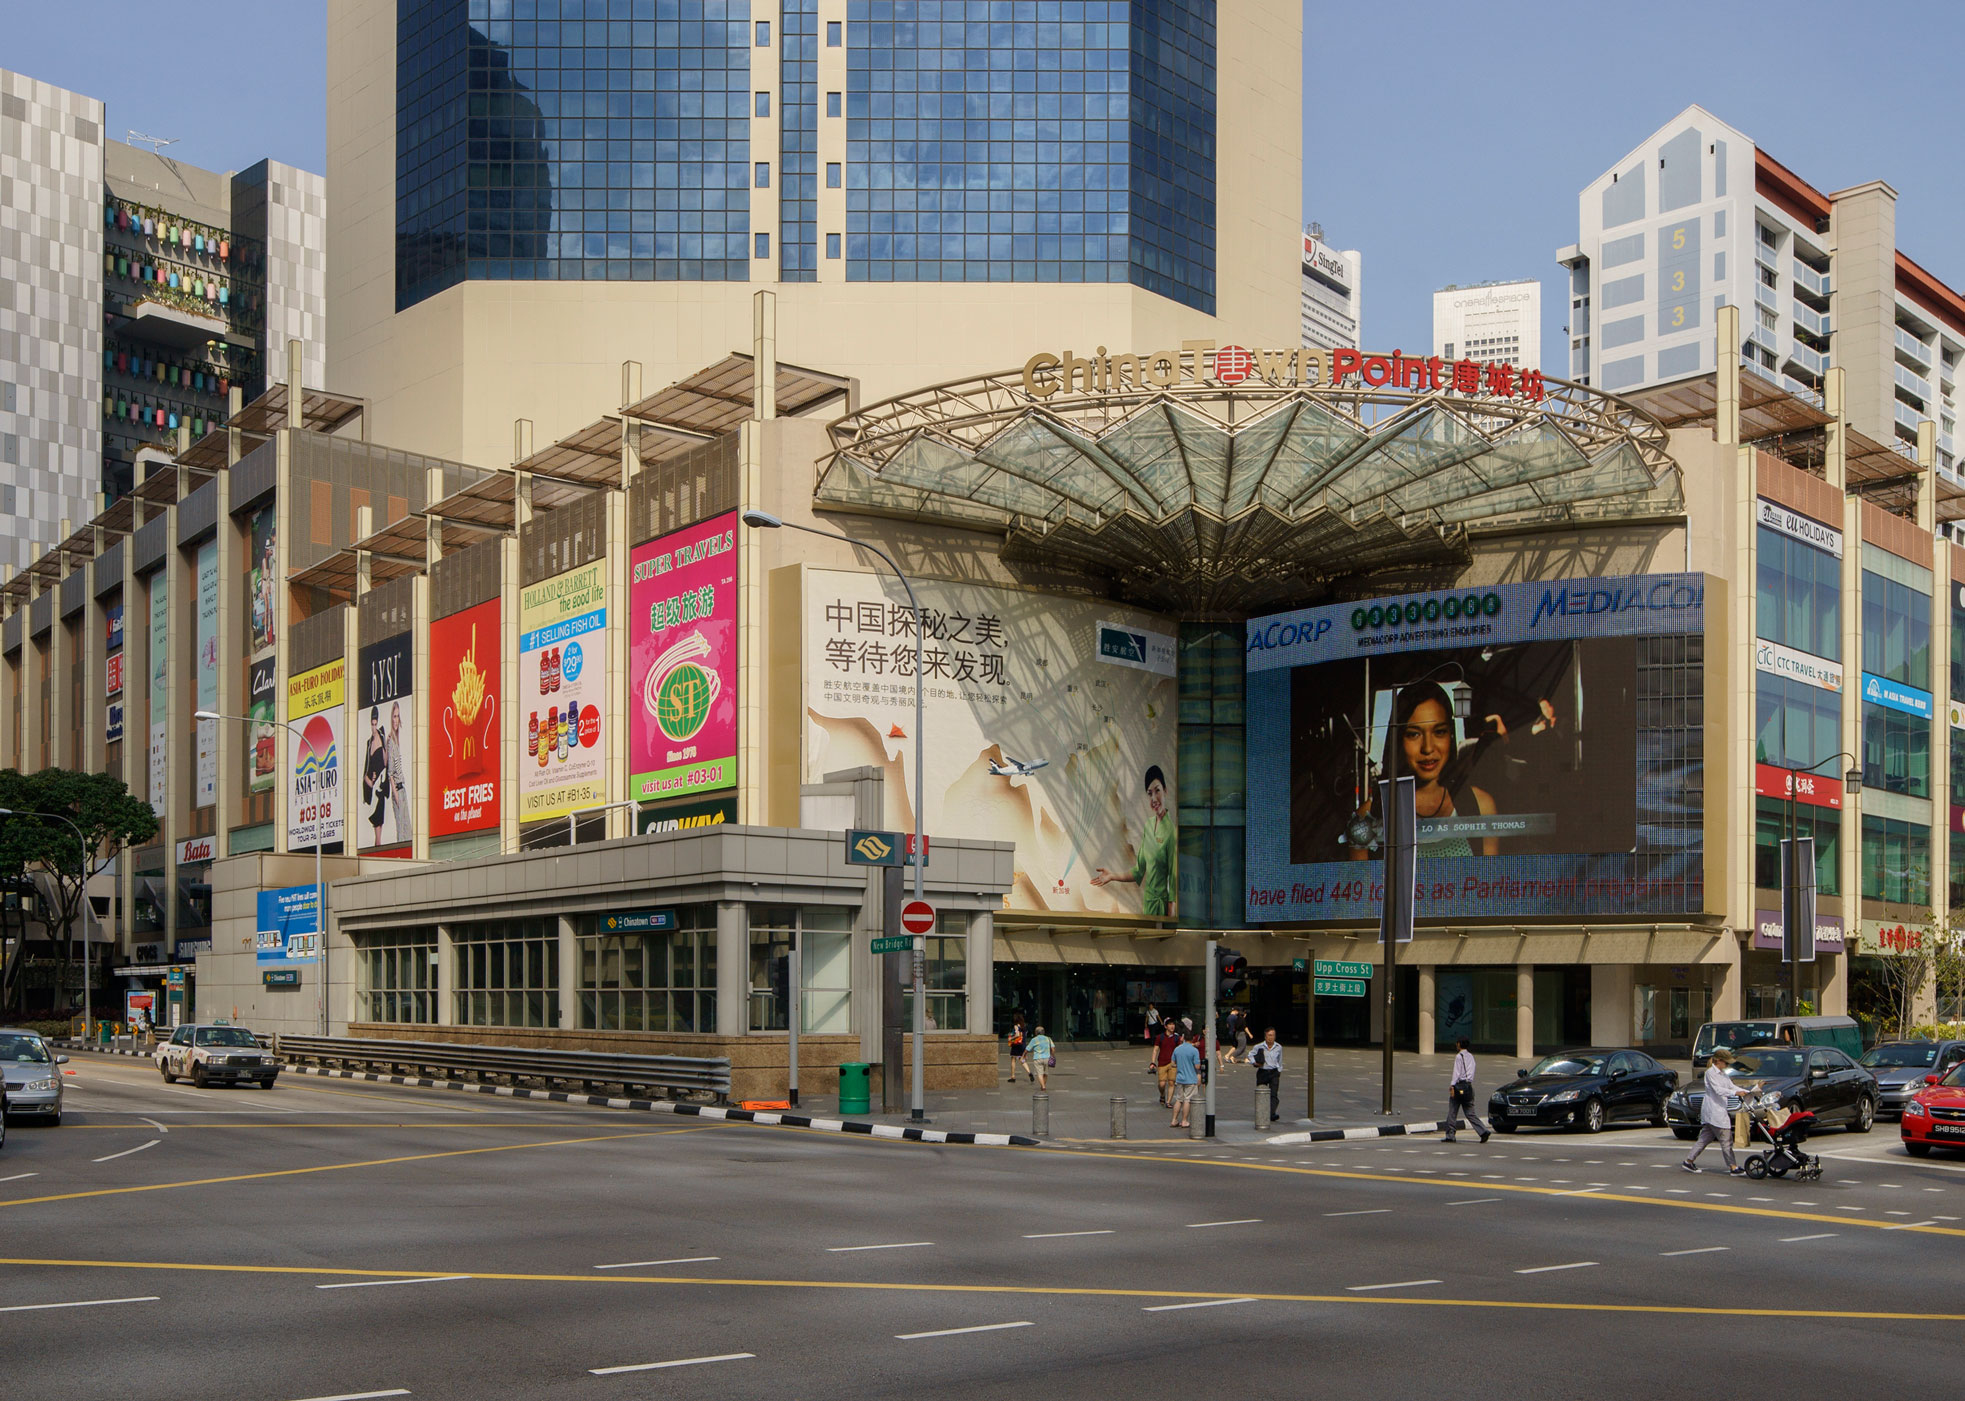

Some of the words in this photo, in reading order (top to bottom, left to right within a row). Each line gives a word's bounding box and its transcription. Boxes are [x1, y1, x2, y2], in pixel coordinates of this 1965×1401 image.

[1318, 252, 1344, 278] SingTel
[1333, 348, 1444, 391] Point
[1452, 358, 1546, 402] 唐城坊
[1786, 515, 1798, 533] eu
[1799, 520, 1835, 548] HOLIDAYS
[634, 553, 673, 584] SUPER
[675, 530, 734, 568] TRAVELS
[524, 583, 556, 611] HOLLAND
[557, 580, 564, 598] &
[565, 567, 598, 594] BARRETT
[560, 597, 571, 613] the
[572, 589, 590, 609] good
[591, 585, 604, 603] life
[650, 584, 715, 633] 超级旅游
[529, 632, 540, 650] #1
[541, 624, 570, 644] SELLING
[571, 618, 588, 634] FISH
[589, 614, 601, 629] OIL
[1247, 618, 1332, 653] ACORP
[1104, 643, 1135, 657] 胜安航空
[825, 637, 1010, 687] 等待您来发现。
[1776, 657, 1790, 671] CTC
[1791, 661, 1816, 679] TRAVEL
[290, 674, 319, 697] ASIA-EURO
[1020, 692, 1032, 700] 昆明
[670, 679, 700, 723] ST
[578, 719, 585, 737] 2
[595, 715, 600, 733] 1
[642, 777, 660, 794] visit
[662, 779, 672, 792] us
[673, 776, 684, 790] at
[687, 765, 723, 787] #03-01
[444, 788, 467, 810] BEST
[468, 783, 494, 806] FRIES
[527, 794, 544, 809] VISIT
[545, 792, 556, 806] US
[556, 790, 566, 803] AT
[567, 786, 591, 802] #B1-35
[460, 808, 468, 821] the
[289, 825, 316, 837] WORLDWIDE
[297, 834, 310, 843] TOUR
[1421, 824, 1433, 833] LO
[1437, 823, 1449, 832] AS
[1453, 822, 1487, 832] SOPHIE
[1492, 821, 1526, 830] THOMAS
[184, 840, 211, 862] Bata
[909, 855, 926, 864] MT
[1052, 886, 1070, 895] 新加坡
[1249, 885, 1286, 906] have
[1291, 882, 1325, 904] filed
[1330, 880, 1363, 902] 449
[1431, 882, 1455, 900] as
[1462, 875, 1577, 899] Parliament
[624, 916, 649, 927] Chinatown
[872, 940, 883, 951] New
[885, 937, 904, 950] Bridge
[904, 937, 912, 948] Rd
[1316, 961, 1332, 975] Upp
[1336, 962, 1357, 975] Cross
[1360, 963, 1369, 975] St
[1317, 982, 1361, 994] 克罗士街上段
